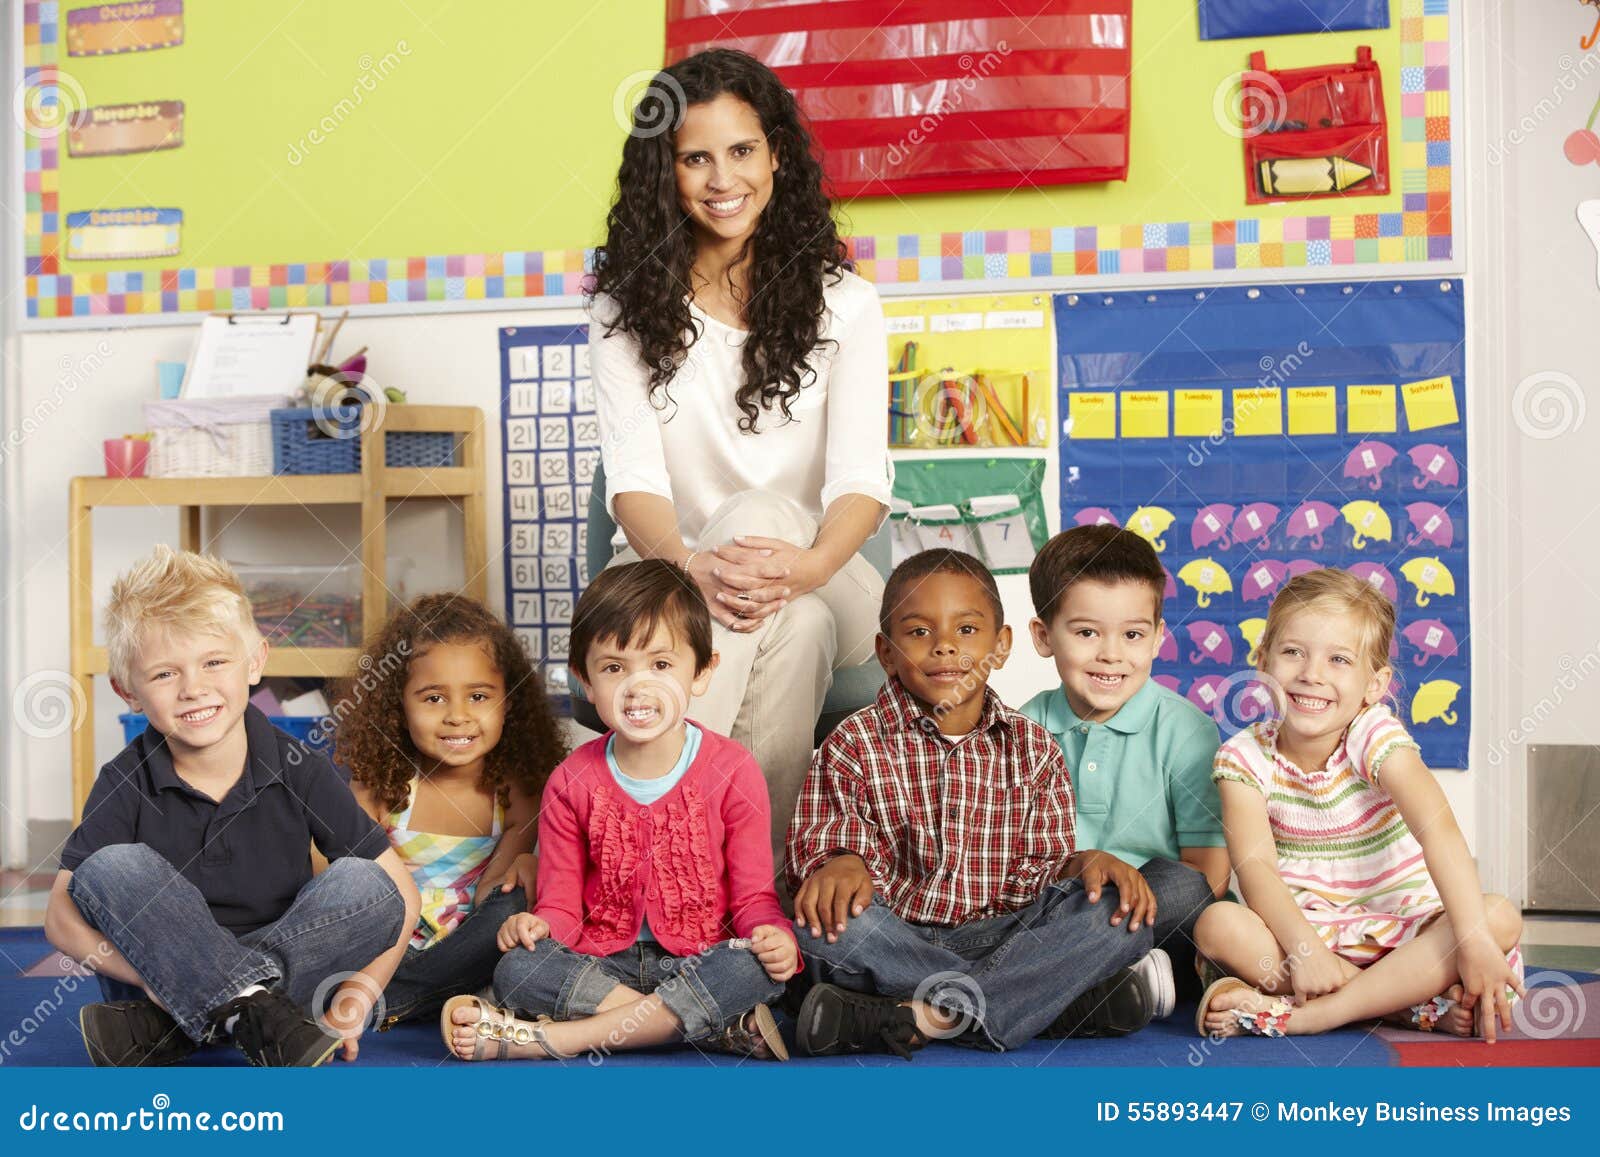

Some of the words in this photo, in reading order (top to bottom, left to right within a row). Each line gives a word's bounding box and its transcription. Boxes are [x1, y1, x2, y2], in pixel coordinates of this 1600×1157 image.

[521, 354, 528, 372] 1
[551, 352, 563, 372] 2
[517, 389, 531, 407] 11
[548, 387, 564, 407] 12
[1079, 396, 1105, 407] Sunday
[1130, 393, 1159, 404] Monday
[1184, 392, 1213, 402] Tuesday
[1295, 390, 1328, 400] Thursday
[1361, 388, 1383, 399] Friday
[1409, 381, 1444, 396] Saturday
[512, 425, 532, 445] 21
[543, 424, 566, 444] 22
[576, 422, 599, 442] 23
[511, 459, 531, 479] 31
[543, 458, 566, 478] 32
[513, 493, 535, 511] 41
[546, 492, 570, 511] 42
[515, 529, 535, 550] 51
[546, 529, 569, 549] 52
[938, 525, 954, 542] 4
[996, 522, 1011, 542] 7
[515, 564, 535, 584] 61
[544, 563, 568, 583] 62
[518, 600, 538, 619] 71
[548, 598, 571, 619] 72
[519, 634, 538, 653] 81
[550, 634, 570, 654] 82
